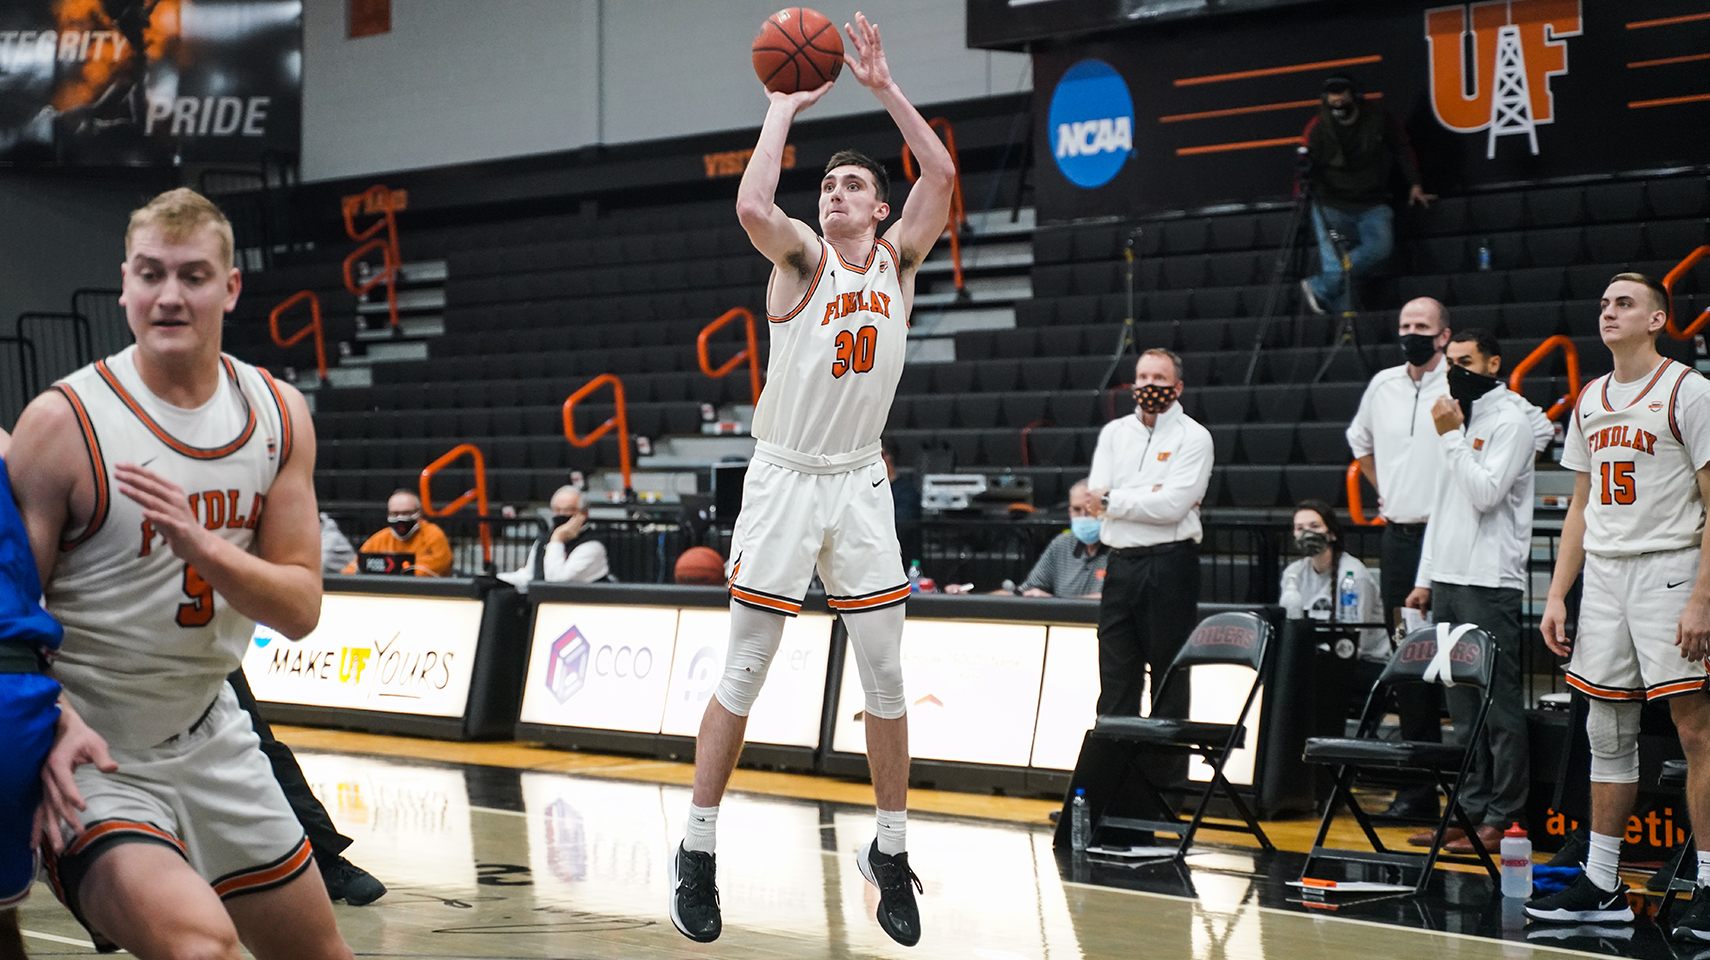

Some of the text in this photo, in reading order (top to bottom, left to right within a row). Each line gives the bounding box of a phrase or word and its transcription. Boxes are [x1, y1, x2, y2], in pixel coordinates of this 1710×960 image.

[1425, 0, 1583, 134] UF
[144, 96, 270, 136] PRIDE
[1056, 116, 1132, 159] NCAA
[831, 325, 878, 379] 30
[1588, 425, 1658, 458] FINDLAY
[1600, 461, 1637, 505] 15
[1191, 625, 1257, 650] OILERS
[1400, 640, 1481, 665] OILRS
[268, 630, 455, 699] MAKE UF YOURS
[595, 644, 653, 680] CCO
